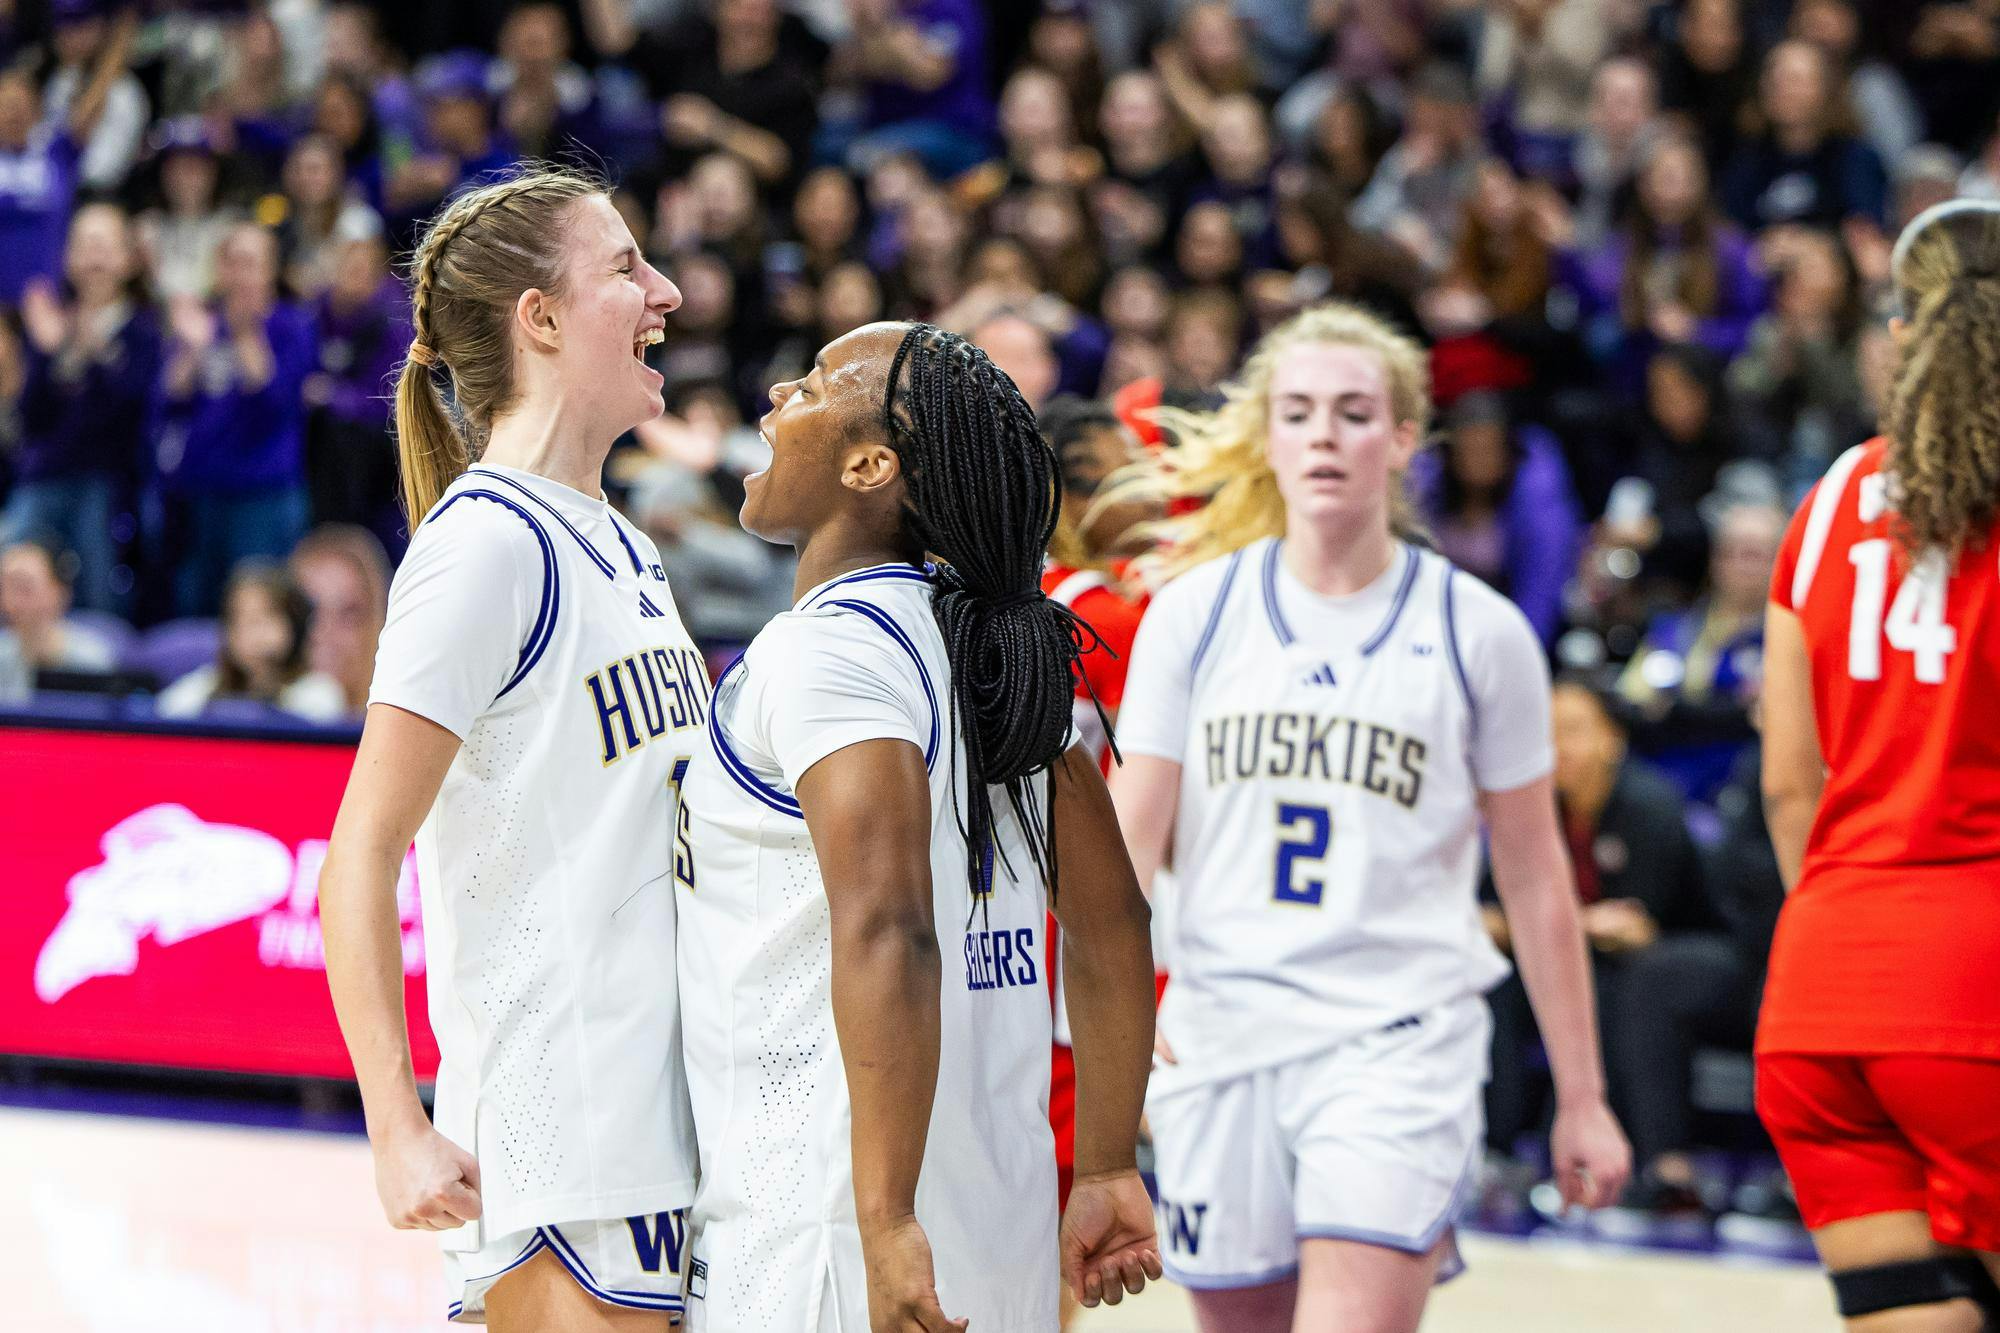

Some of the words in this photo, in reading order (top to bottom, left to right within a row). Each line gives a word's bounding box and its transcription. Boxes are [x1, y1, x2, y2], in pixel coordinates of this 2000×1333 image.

[1848, 537, 1957, 684] 14
[1204, 711, 1428, 811] HUSKIES
[1271, 798, 1334, 910] 2
[624, 1207, 685, 1276] W
